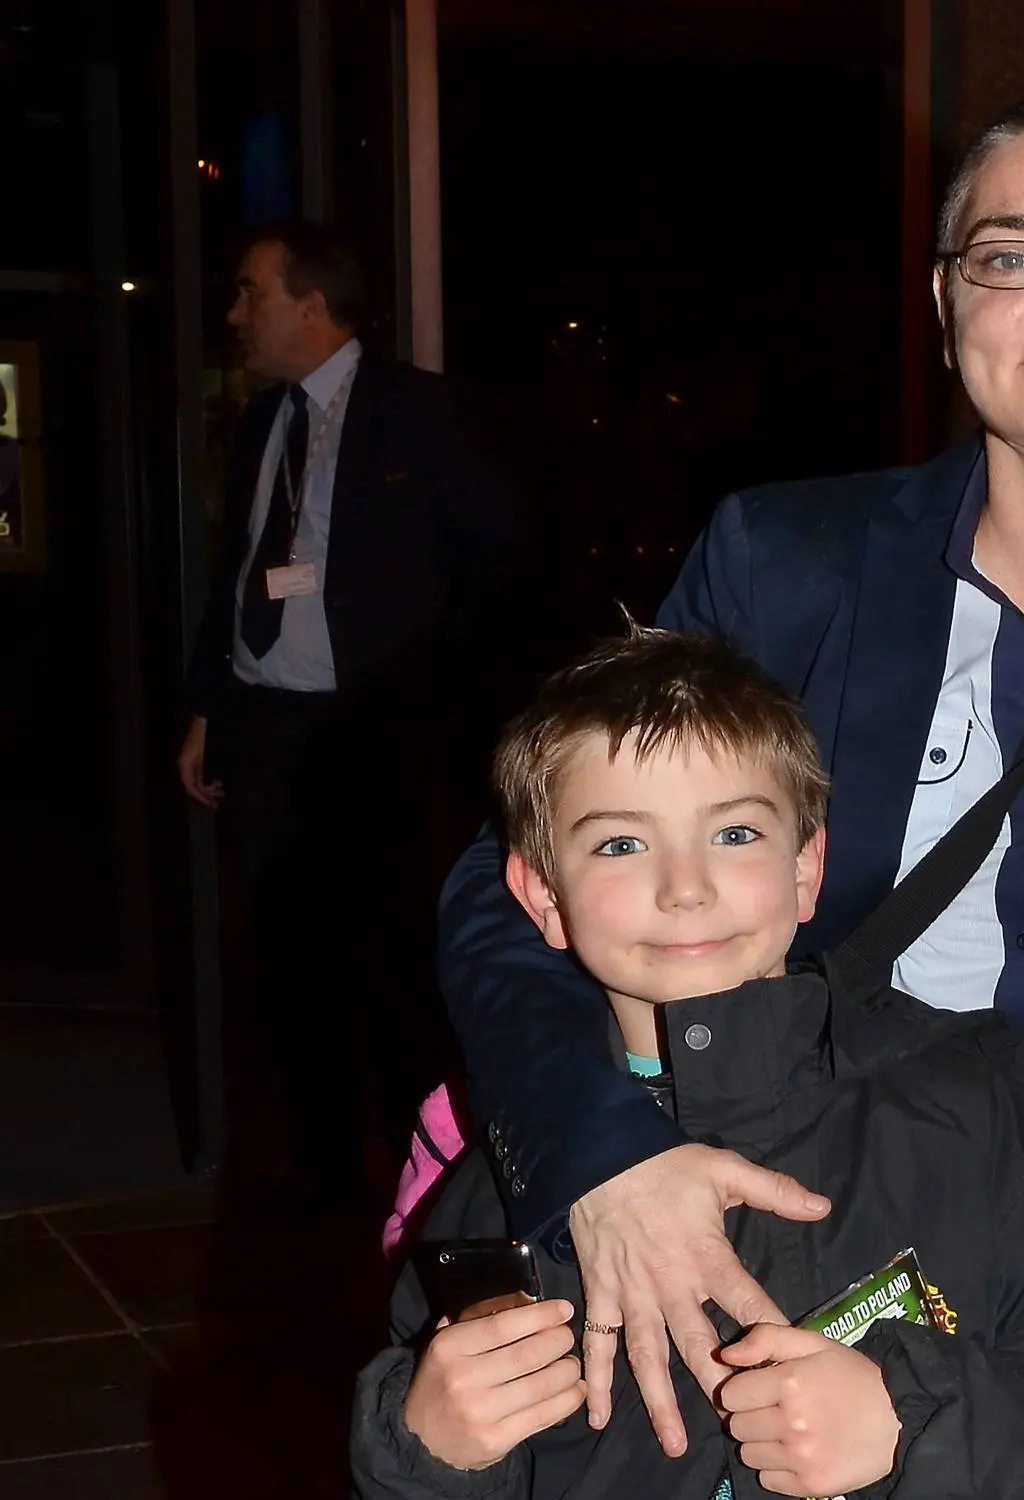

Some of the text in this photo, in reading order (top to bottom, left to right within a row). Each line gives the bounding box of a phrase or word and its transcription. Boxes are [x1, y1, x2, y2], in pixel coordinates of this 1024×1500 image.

[823, 1312, 856, 1340] ROAD
[852, 1301, 871, 1323] TO
[867, 1272, 911, 1314] POLAND
